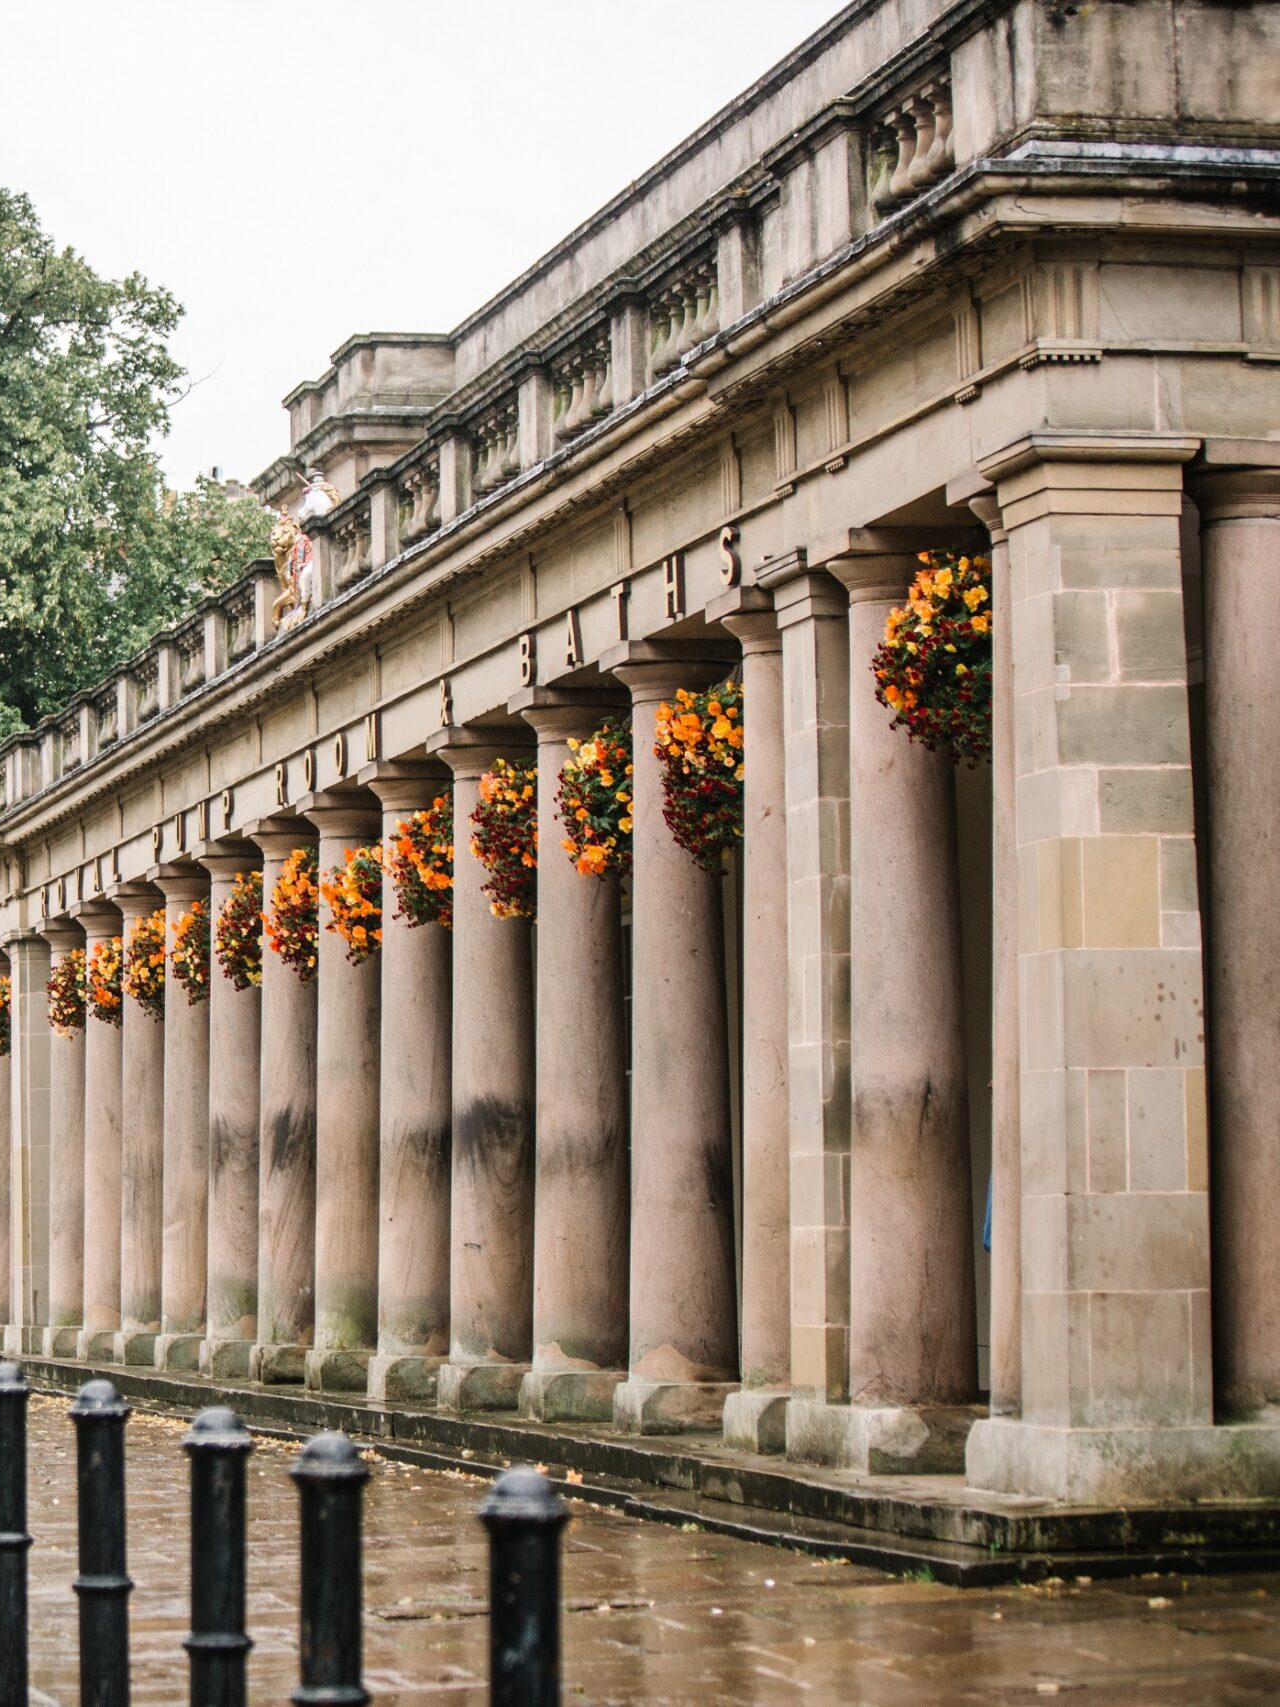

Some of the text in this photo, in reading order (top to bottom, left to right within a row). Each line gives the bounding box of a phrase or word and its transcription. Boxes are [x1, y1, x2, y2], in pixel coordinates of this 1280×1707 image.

[40, 849, 122, 918] ROYAL
[152, 789, 235, 864] PUMP
[275, 712, 382, 807] ROOM
[439, 679, 454, 727] &
